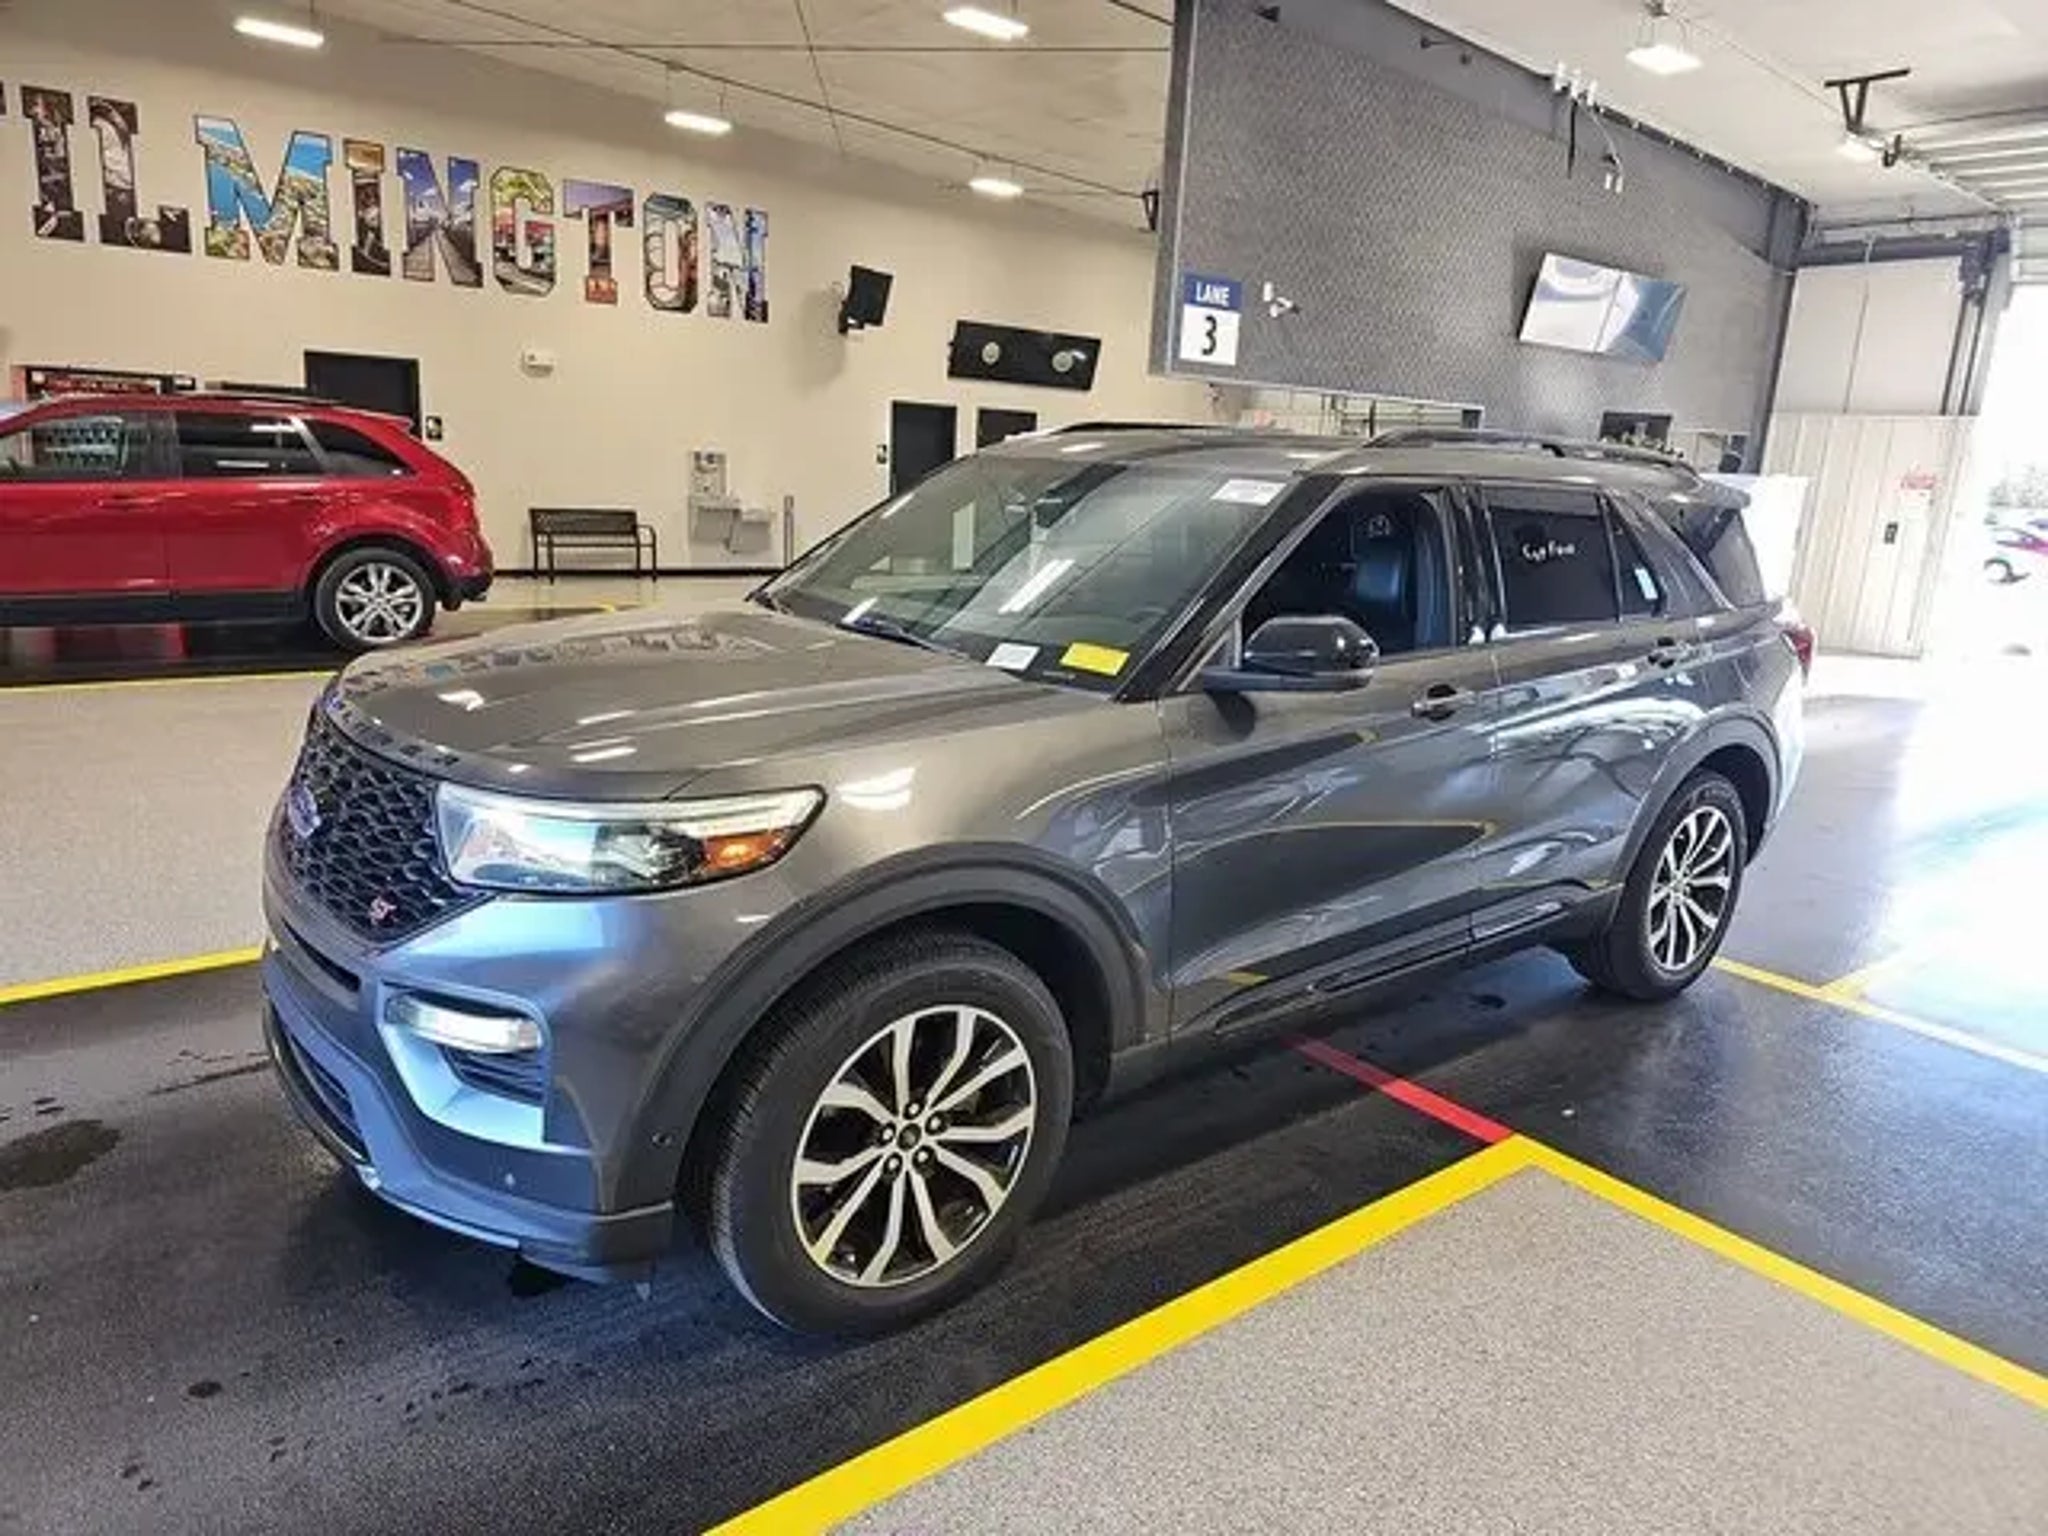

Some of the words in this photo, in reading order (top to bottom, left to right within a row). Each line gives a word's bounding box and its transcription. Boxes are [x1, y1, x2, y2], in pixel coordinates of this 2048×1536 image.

[0, 80, 769, 323] ILMINGTON
[1195, 281, 1230, 307] LANE
[1202, 314, 1217, 356] 3
